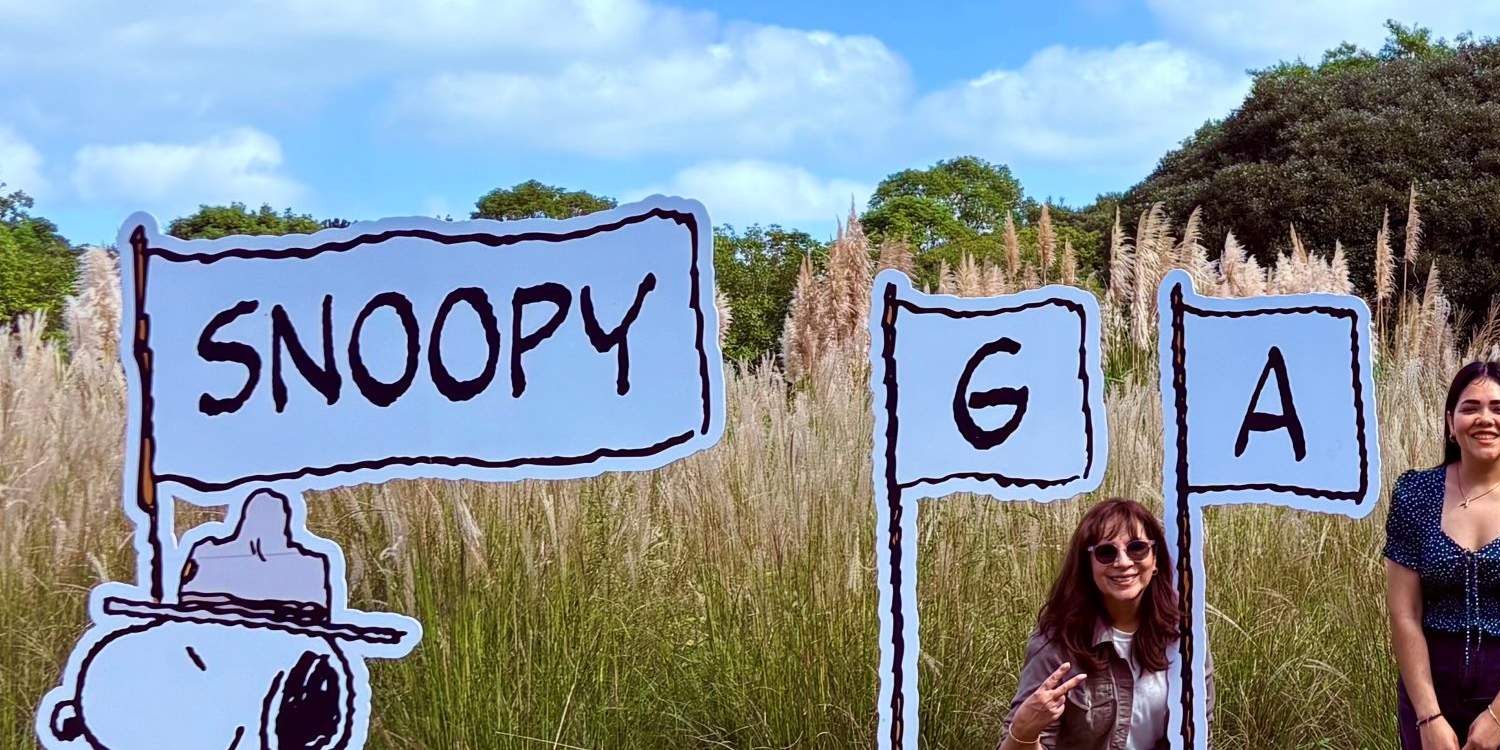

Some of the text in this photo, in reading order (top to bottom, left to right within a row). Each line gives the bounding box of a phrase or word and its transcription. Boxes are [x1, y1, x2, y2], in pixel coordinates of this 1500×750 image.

[197, 272, 657, 416] SNOOPY
[953, 337, 1029, 450] G
[1235, 346, 1307, 462] A
